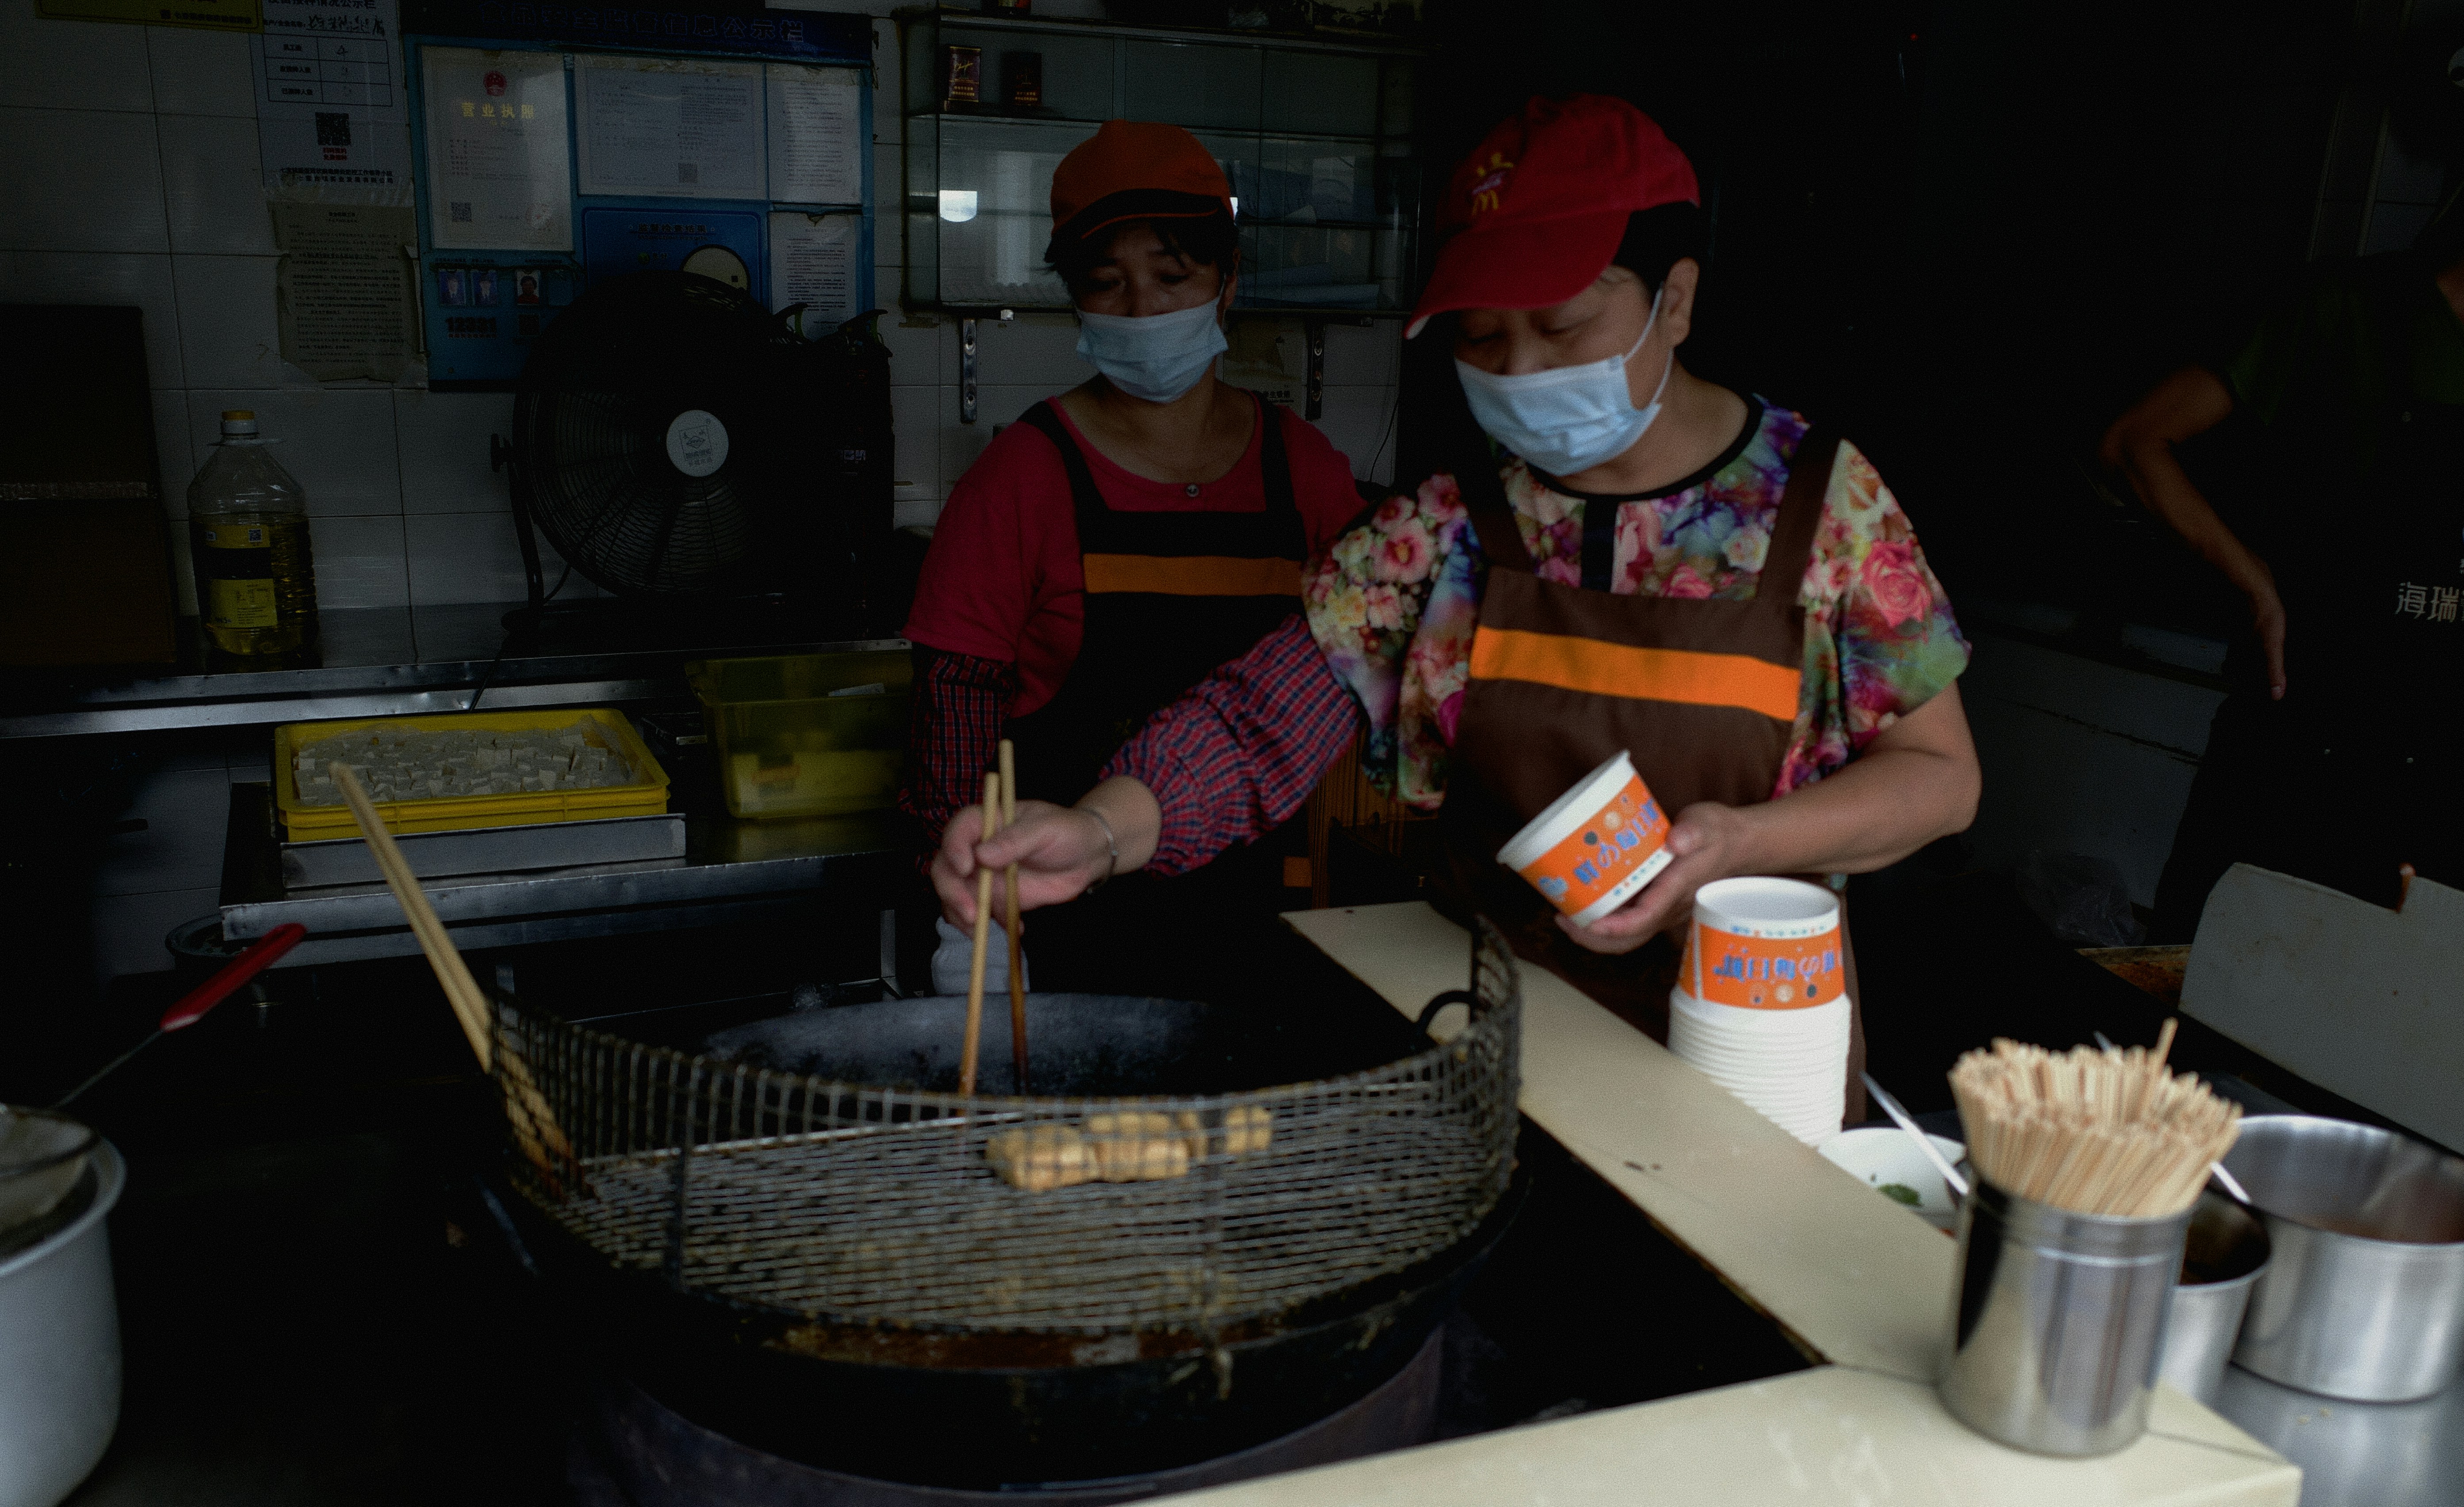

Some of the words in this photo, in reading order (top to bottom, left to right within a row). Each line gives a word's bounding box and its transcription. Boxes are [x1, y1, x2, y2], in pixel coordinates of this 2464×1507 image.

[480, 1, 803, 42] 食品安全监督信息公示栏
[461, 101, 535, 119] 营业执照
[2394, 581, 2464, 622] 海瑞
